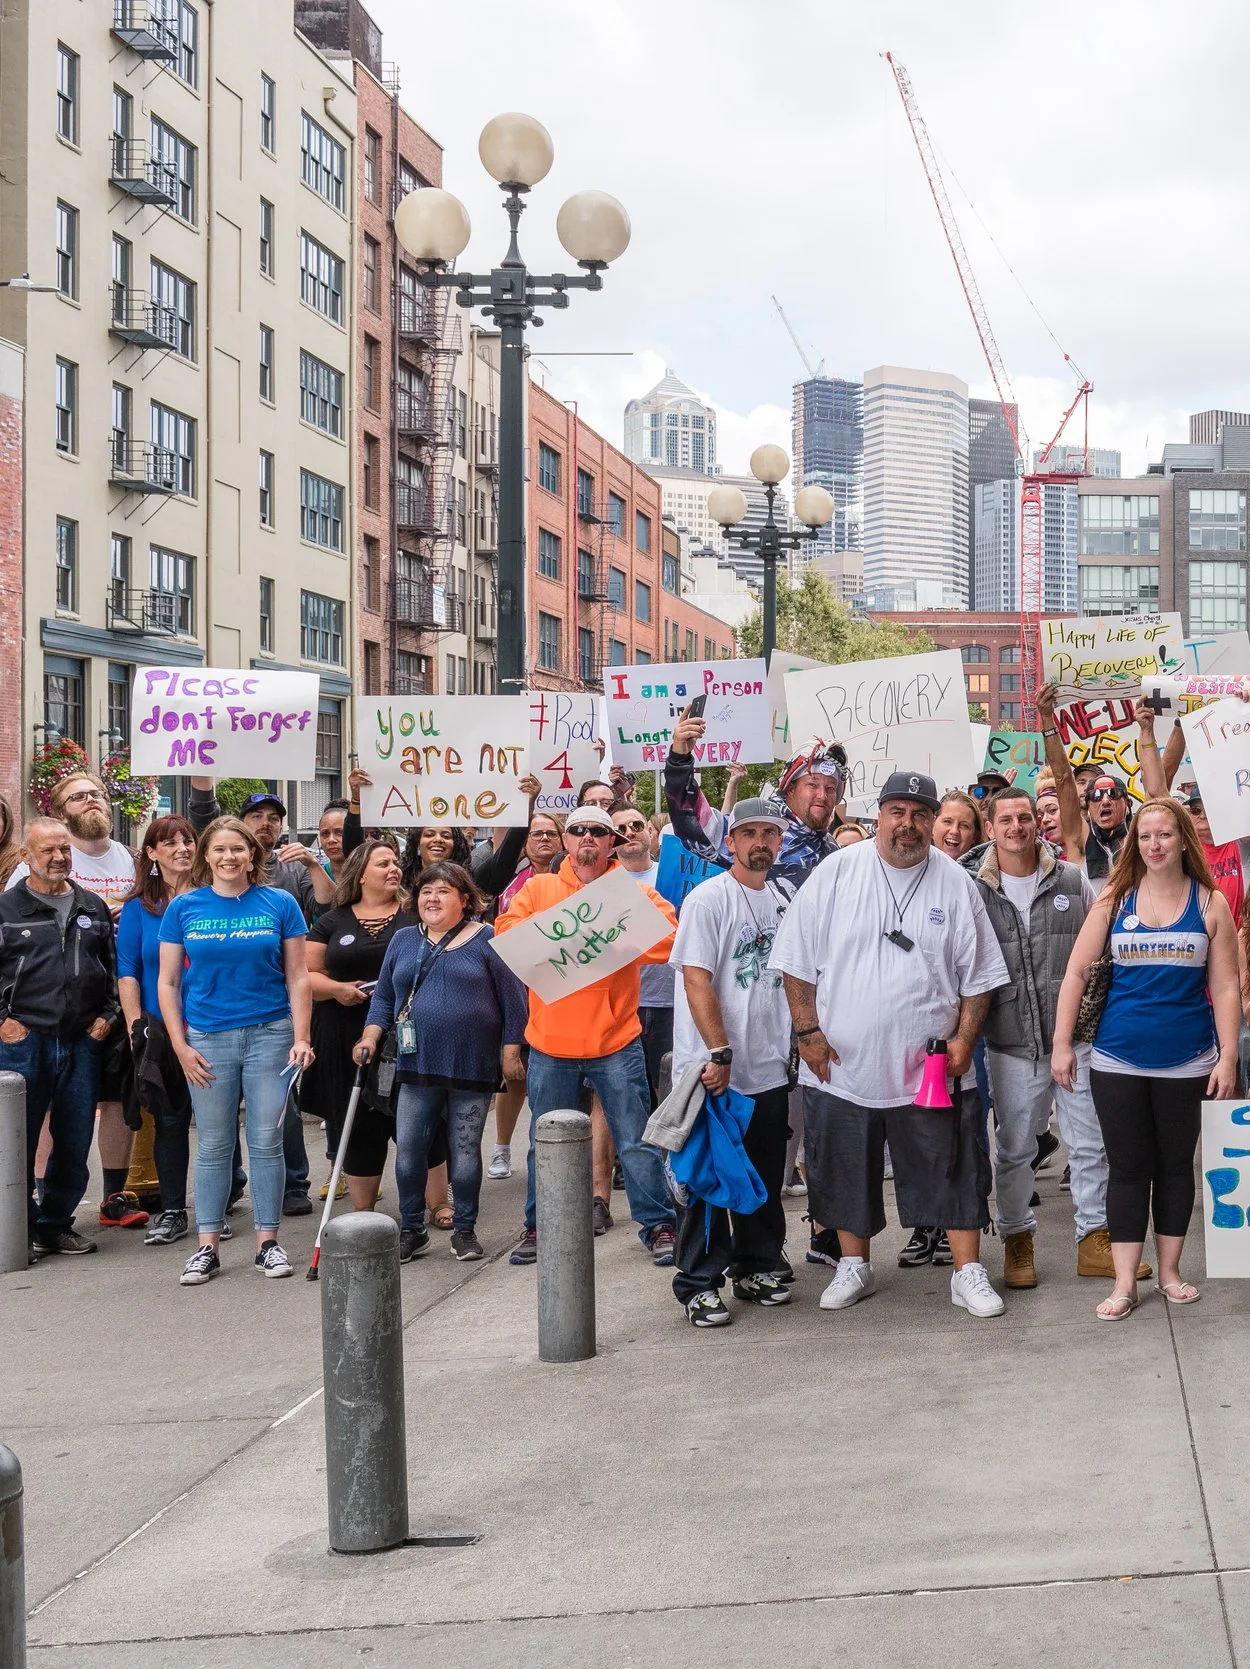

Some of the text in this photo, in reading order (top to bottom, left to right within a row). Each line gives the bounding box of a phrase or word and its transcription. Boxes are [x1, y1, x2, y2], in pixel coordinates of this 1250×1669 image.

[1106, 627, 1137, 643] LIFE
[1144, 625, 1171, 643] OF
[144, 669, 260, 699] Please
[610, 669, 763, 700] I am a Person
[530, 693, 599, 749] #Root
[815, 672, 952, 739] RECOVERY
[139, 704, 312, 744] dont Forget
[375, 705, 441, 761] you
[617, 726, 673, 746] Longt
[399, 744, 464, 777] are
[641, 740, 743, 764] REVERY
[872, 730, 890, 759] 4
[543, 750, 574, 789] 4
[380, 784, 511, 821] Alone
[536, 793, 579, 813] ecove
[533, 902, 603, 942] We
[549, 912, 631, 980] Matter
[1117, 941, 1196, 960] MARINERS
